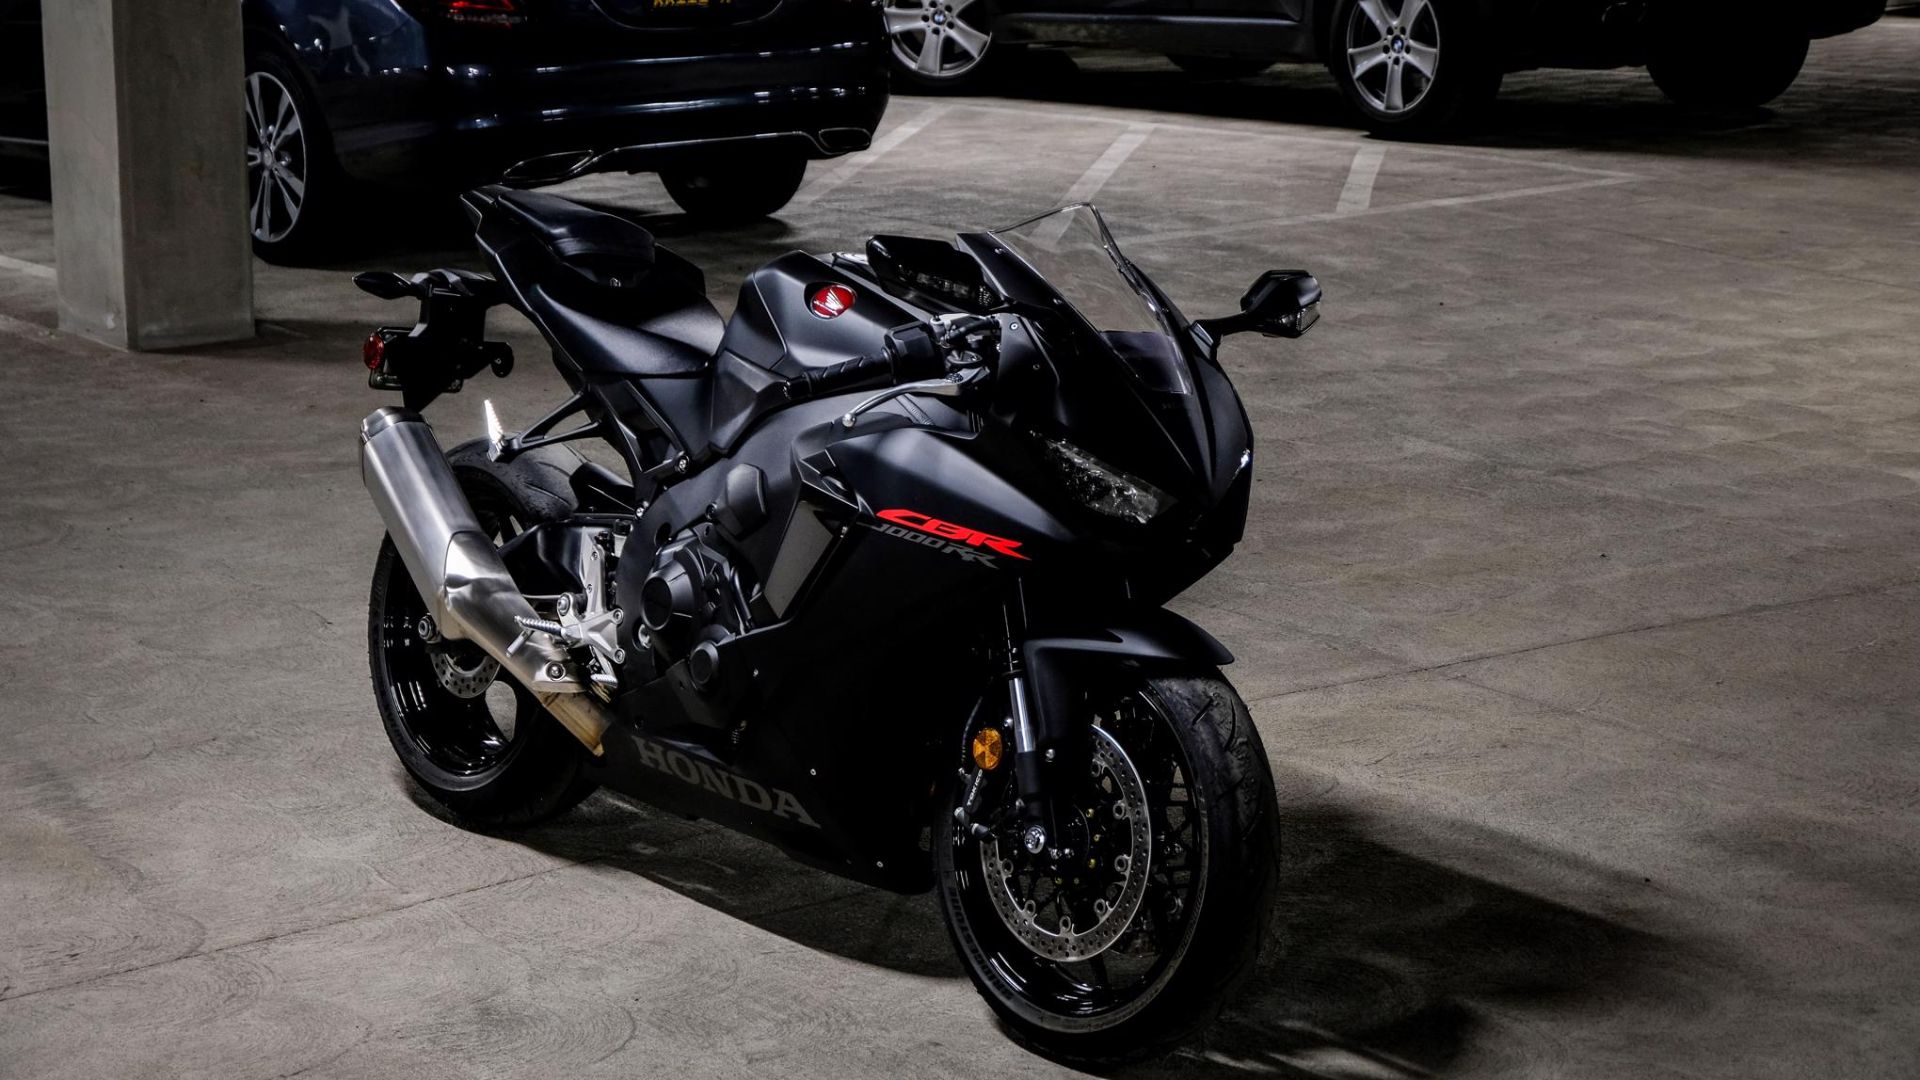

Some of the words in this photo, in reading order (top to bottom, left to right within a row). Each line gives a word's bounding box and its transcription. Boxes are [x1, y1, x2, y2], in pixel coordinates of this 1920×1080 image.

[856, 521, 1000, 570] 1000RR
[875, 508, 1032, 561] CBR
[631, 735, 822, 829] HONDA
